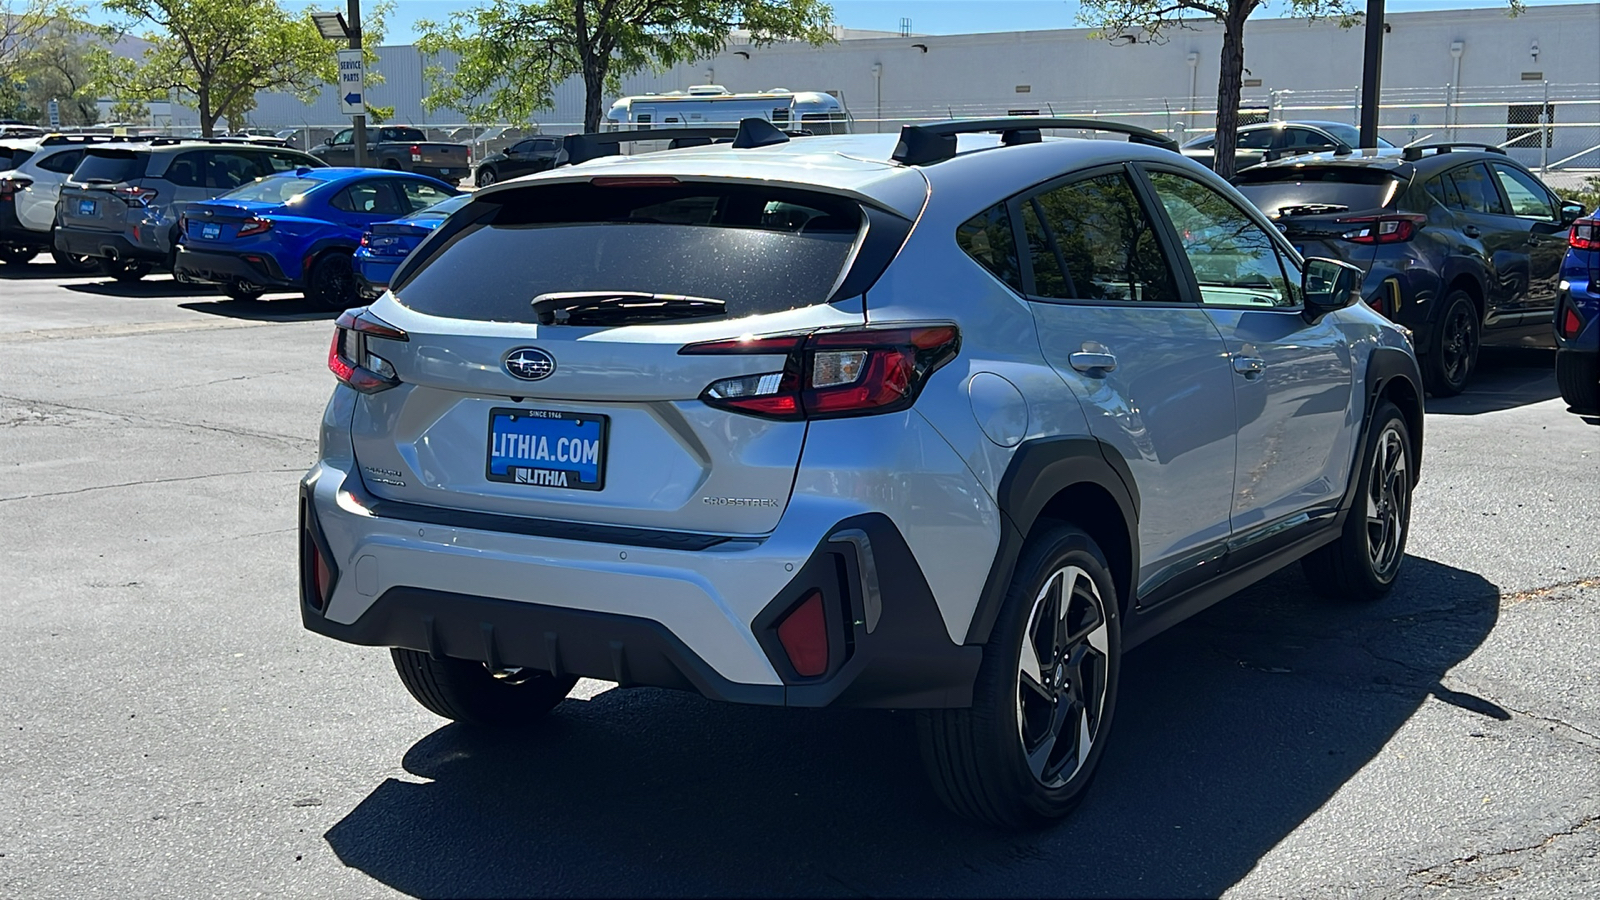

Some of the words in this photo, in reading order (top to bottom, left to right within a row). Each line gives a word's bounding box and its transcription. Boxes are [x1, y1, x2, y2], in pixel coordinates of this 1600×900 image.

[340, 60, 361, 70] SERVICE
[343, 73, 359, 82] PARTS
[529, 410, 547, 418] SINCE
[548, 411, 562, 419] 1946
[491, 432, 599, 465] LITHIA.COM
[527, 468, 568, 487] LITHIA
[702, 496, 779, 507] CROSSTREK
